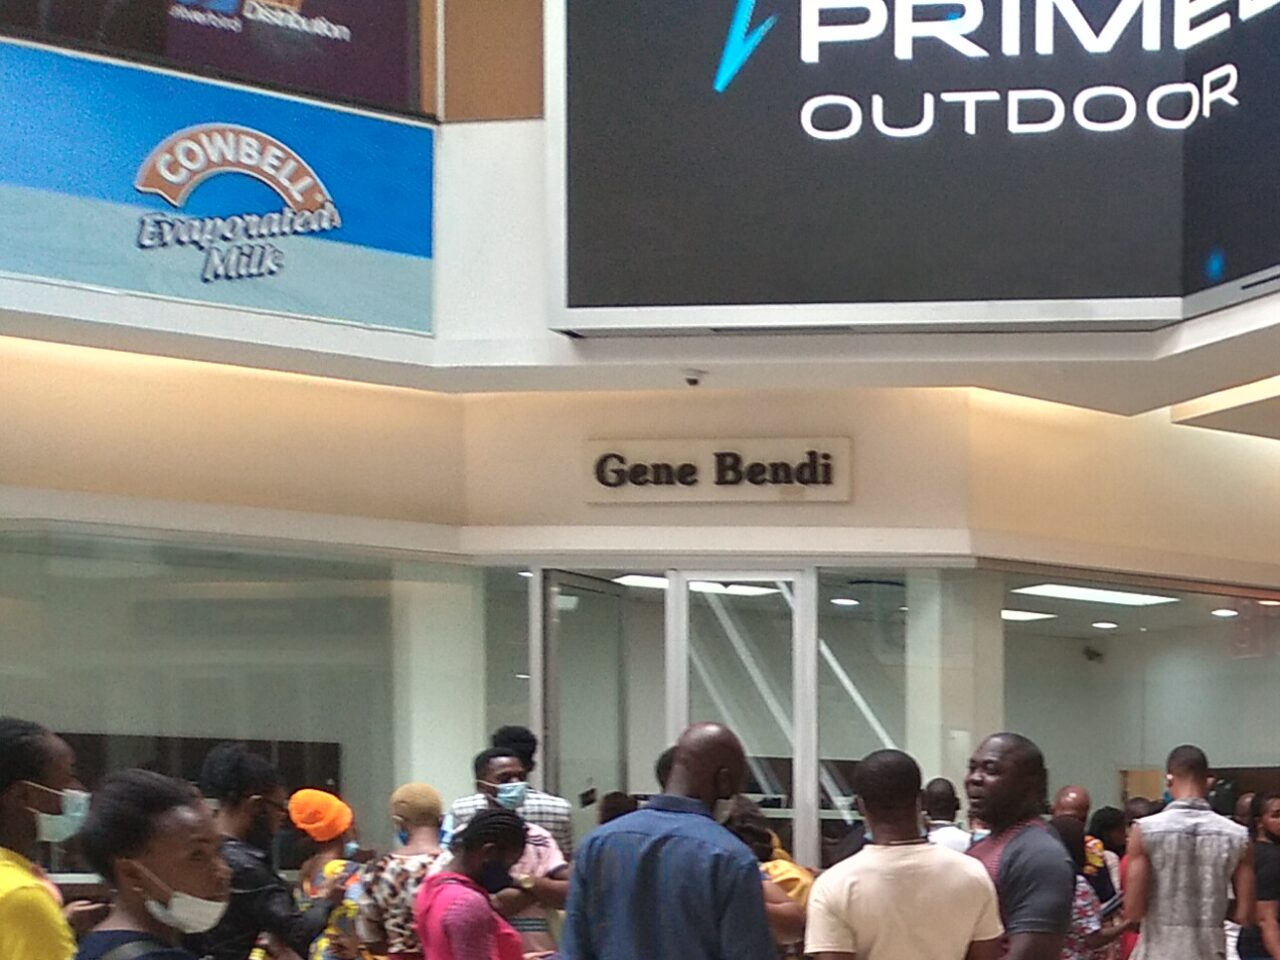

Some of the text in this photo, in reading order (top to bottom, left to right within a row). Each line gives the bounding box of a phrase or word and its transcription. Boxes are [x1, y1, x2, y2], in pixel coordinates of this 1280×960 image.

[800, 64, 1240, 141] OUTDOOR
[156, 131, 314, 203] COWBELL
[138, 199, 342, 250] Evaporated
[201, 242, 284, 283] Milk
[594, 450, 834, 488] Gene Bendi
